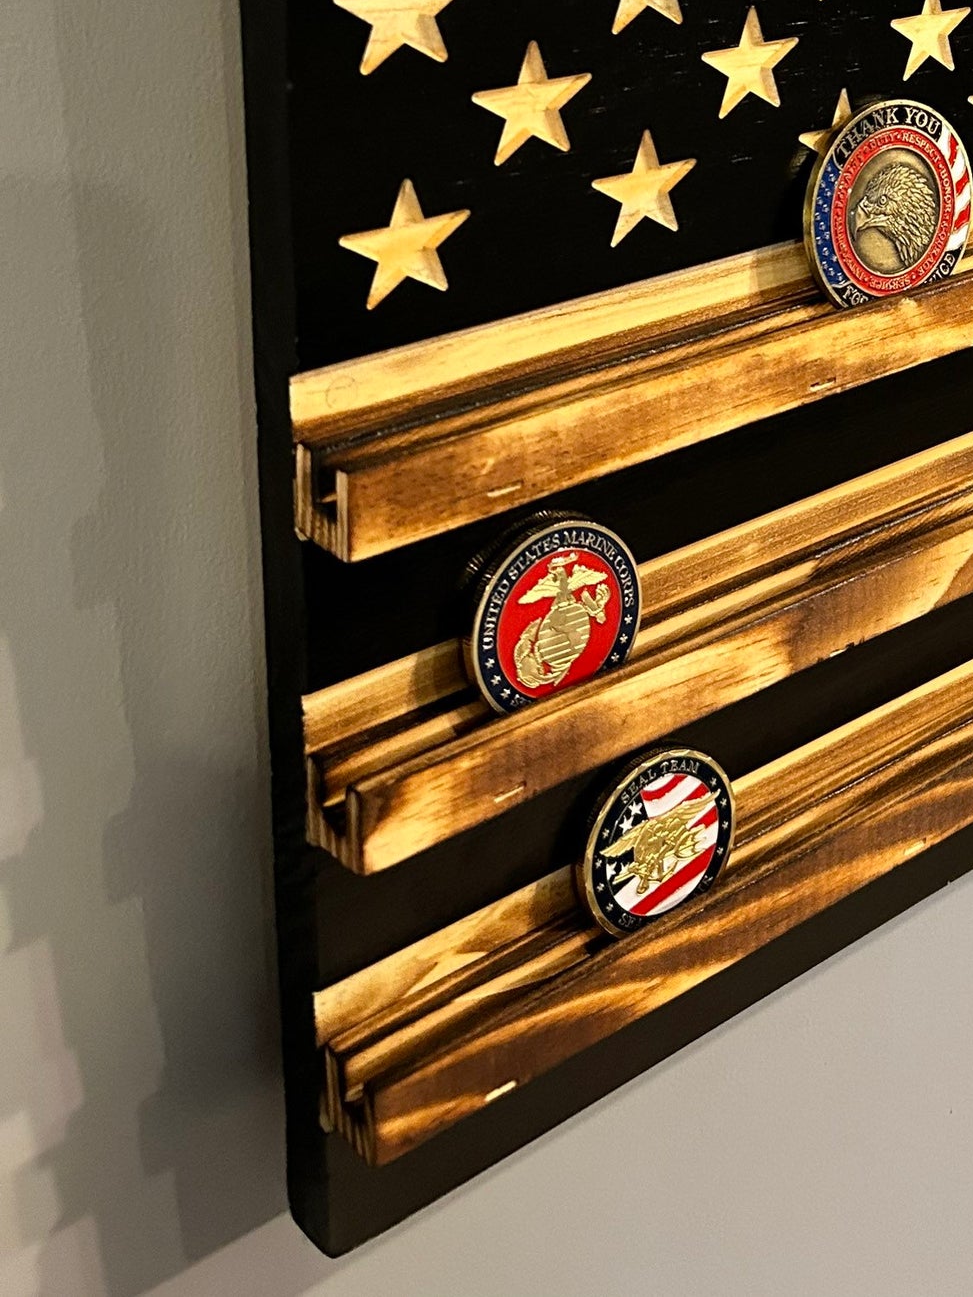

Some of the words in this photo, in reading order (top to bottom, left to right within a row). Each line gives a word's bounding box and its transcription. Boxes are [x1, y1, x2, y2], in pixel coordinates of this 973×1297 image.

[836, 107, 899, 158] THANK
[904, 106, 943, 136] YOU
[901, 132, 941, 163] RESPECT
[940, 169, 954, 213] HONOR
[917, 220, 950, 275] COURAGE
[482, 581, 510, 651] UNITED
[508, 533, 561, 580] STATES
[564, 530, 618, 561] MARINE
[614, 556, 635, 608] CORPS
[621, 770, 657, 804] SEAL
[660, 759, 699, 774] TEAM
